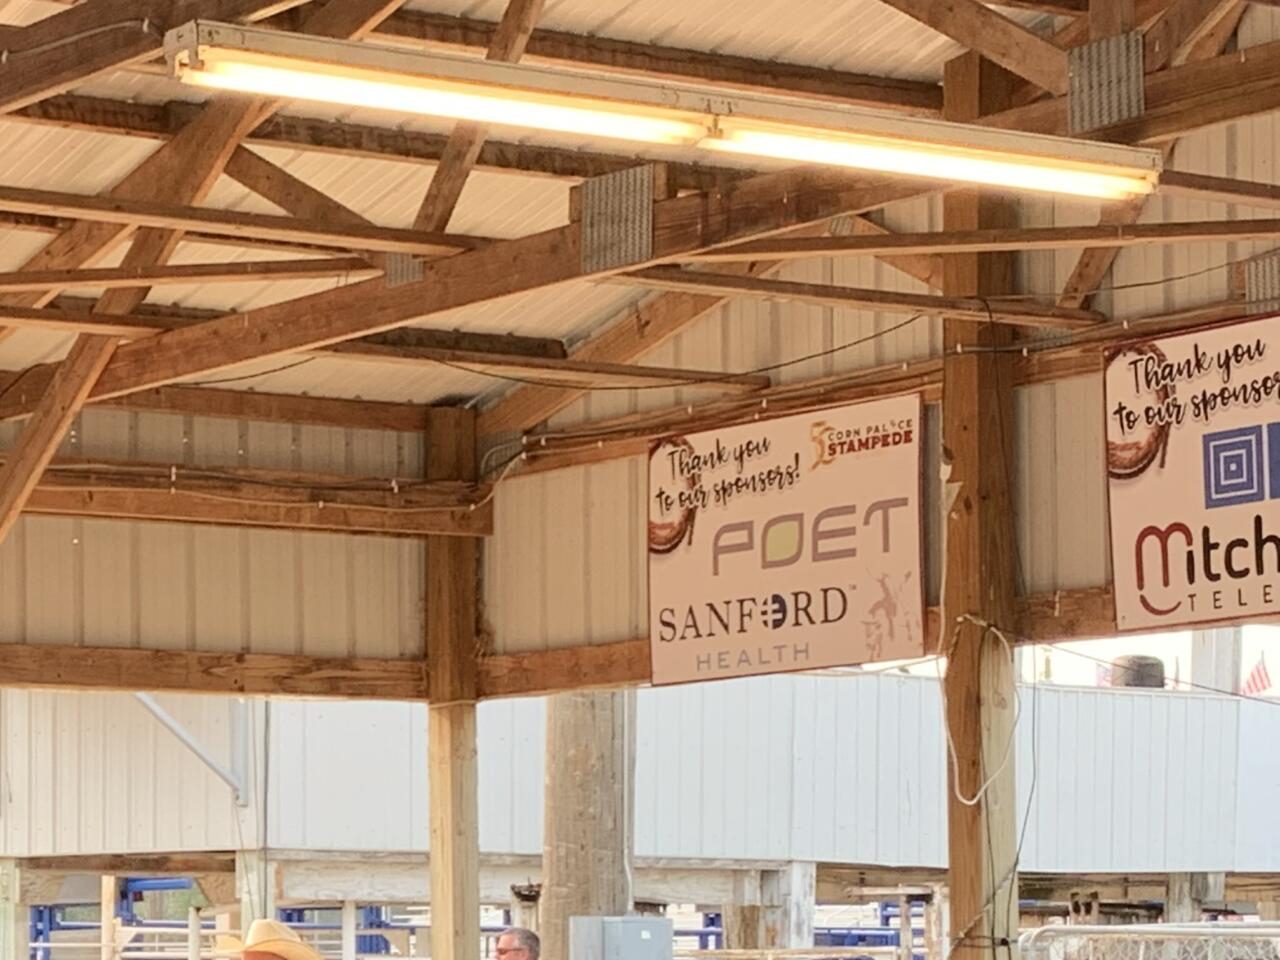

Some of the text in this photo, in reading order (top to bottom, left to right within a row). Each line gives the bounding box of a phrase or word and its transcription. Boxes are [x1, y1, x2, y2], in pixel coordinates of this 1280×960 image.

[1128, 338, 1266, 393] Thank you
[828, 428, 861, 442] CORN
[1112, 401, 1140, 435] to
[1145, 399, 1186, 425] our
[667, 436, 771, 481] Thank you
[828, 430, 913, 457] STAMPEDE
[655, 452, 801, 515] to our sponsors!
[712, 497, 909, 576] POET
[659, 587, 848, 642] SANFORD
[1188, 584, 1274, 612] TELE
[696, 642, 810, 672] HEALTH
